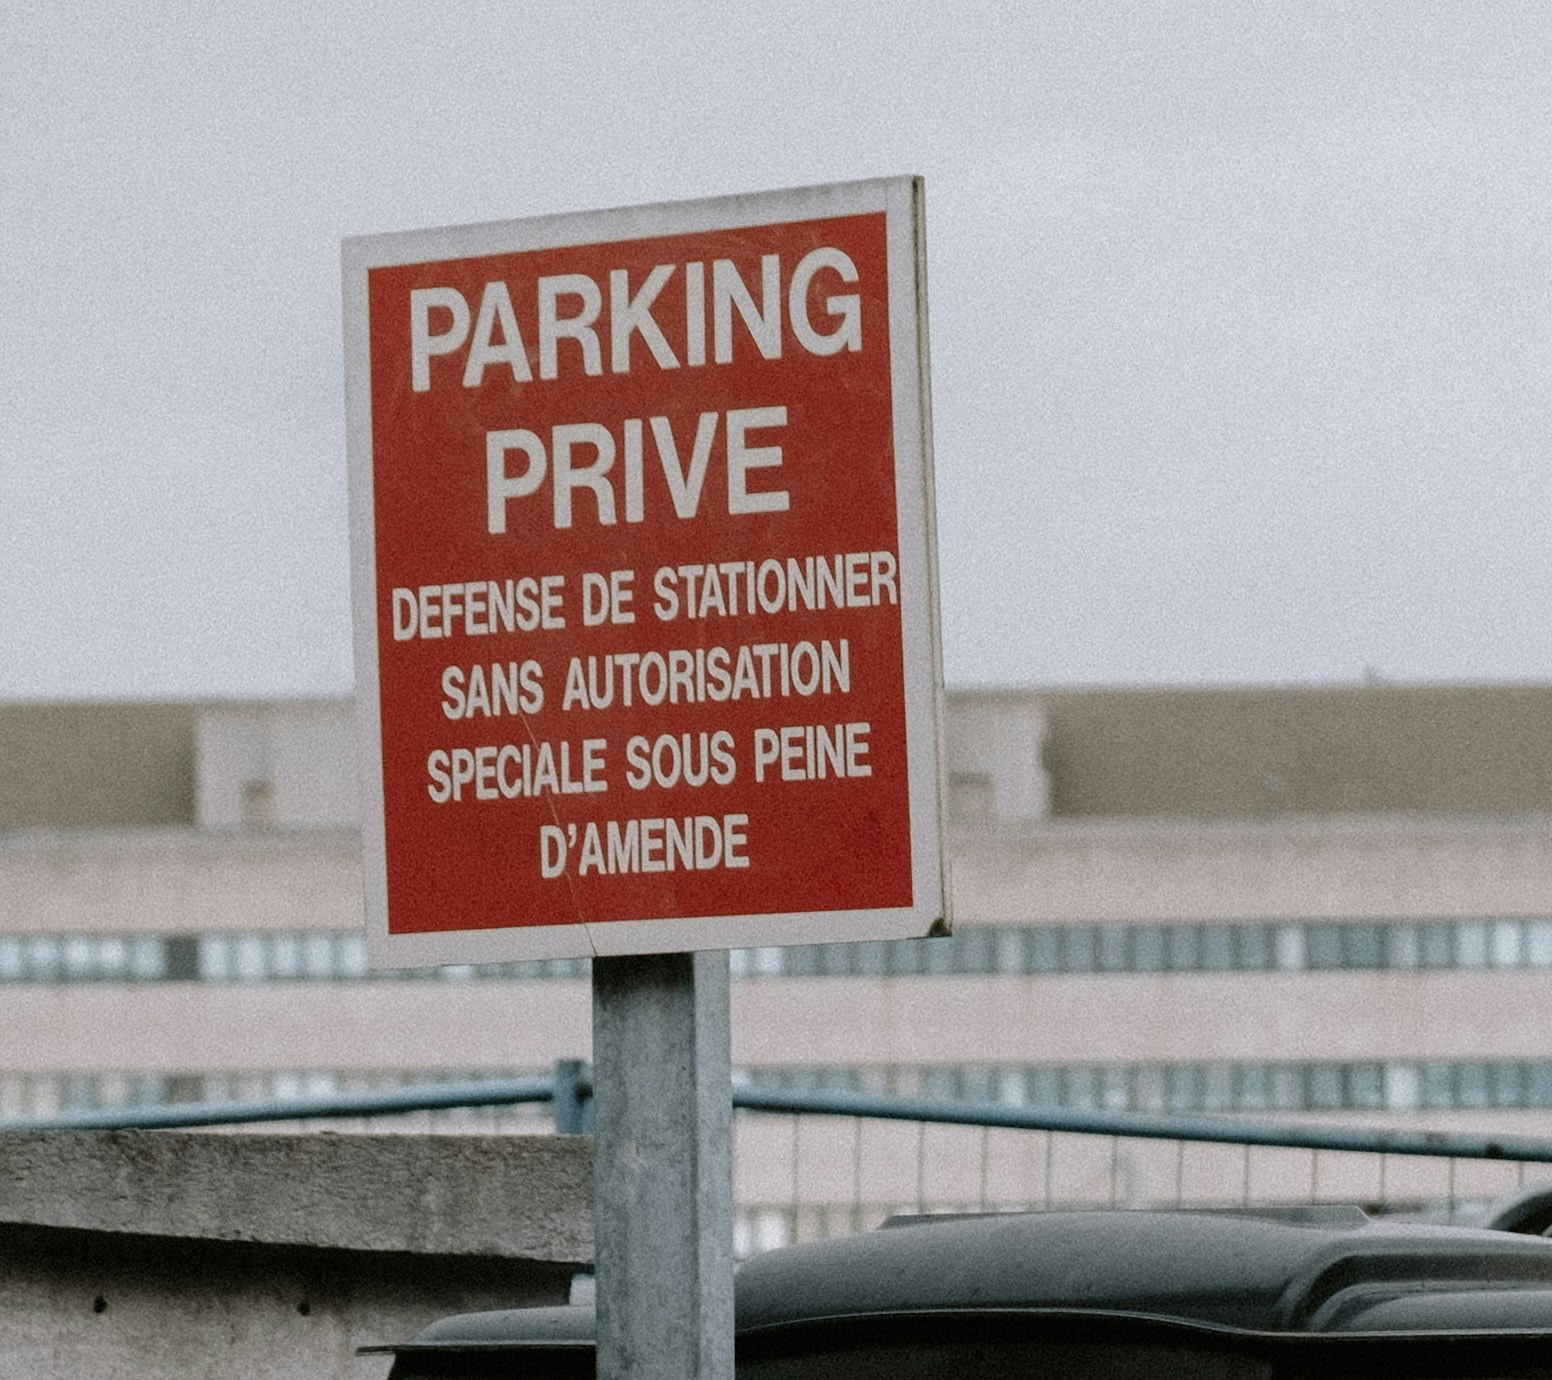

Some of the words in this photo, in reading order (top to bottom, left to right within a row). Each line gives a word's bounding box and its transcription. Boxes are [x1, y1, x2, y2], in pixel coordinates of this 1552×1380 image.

[409, 246, 863, 393] PARKING
[485, 405, 790, 535] PRIVE
[392, 574, 566, 642] DEFENSE
[582, 569, 636, 627] DE
[653, 550, 898, 622] STATIONNER
[441, 659, 545, 720] SANS
[562, 638, 851, 711] AUTORISATION
[427, 738, 608, 804] SPECIALE
[625, 730, 737, 791] SOUS
[754, 721, 873, 783] PEINE
[540, 813, 750, 879] D'AMENDE
